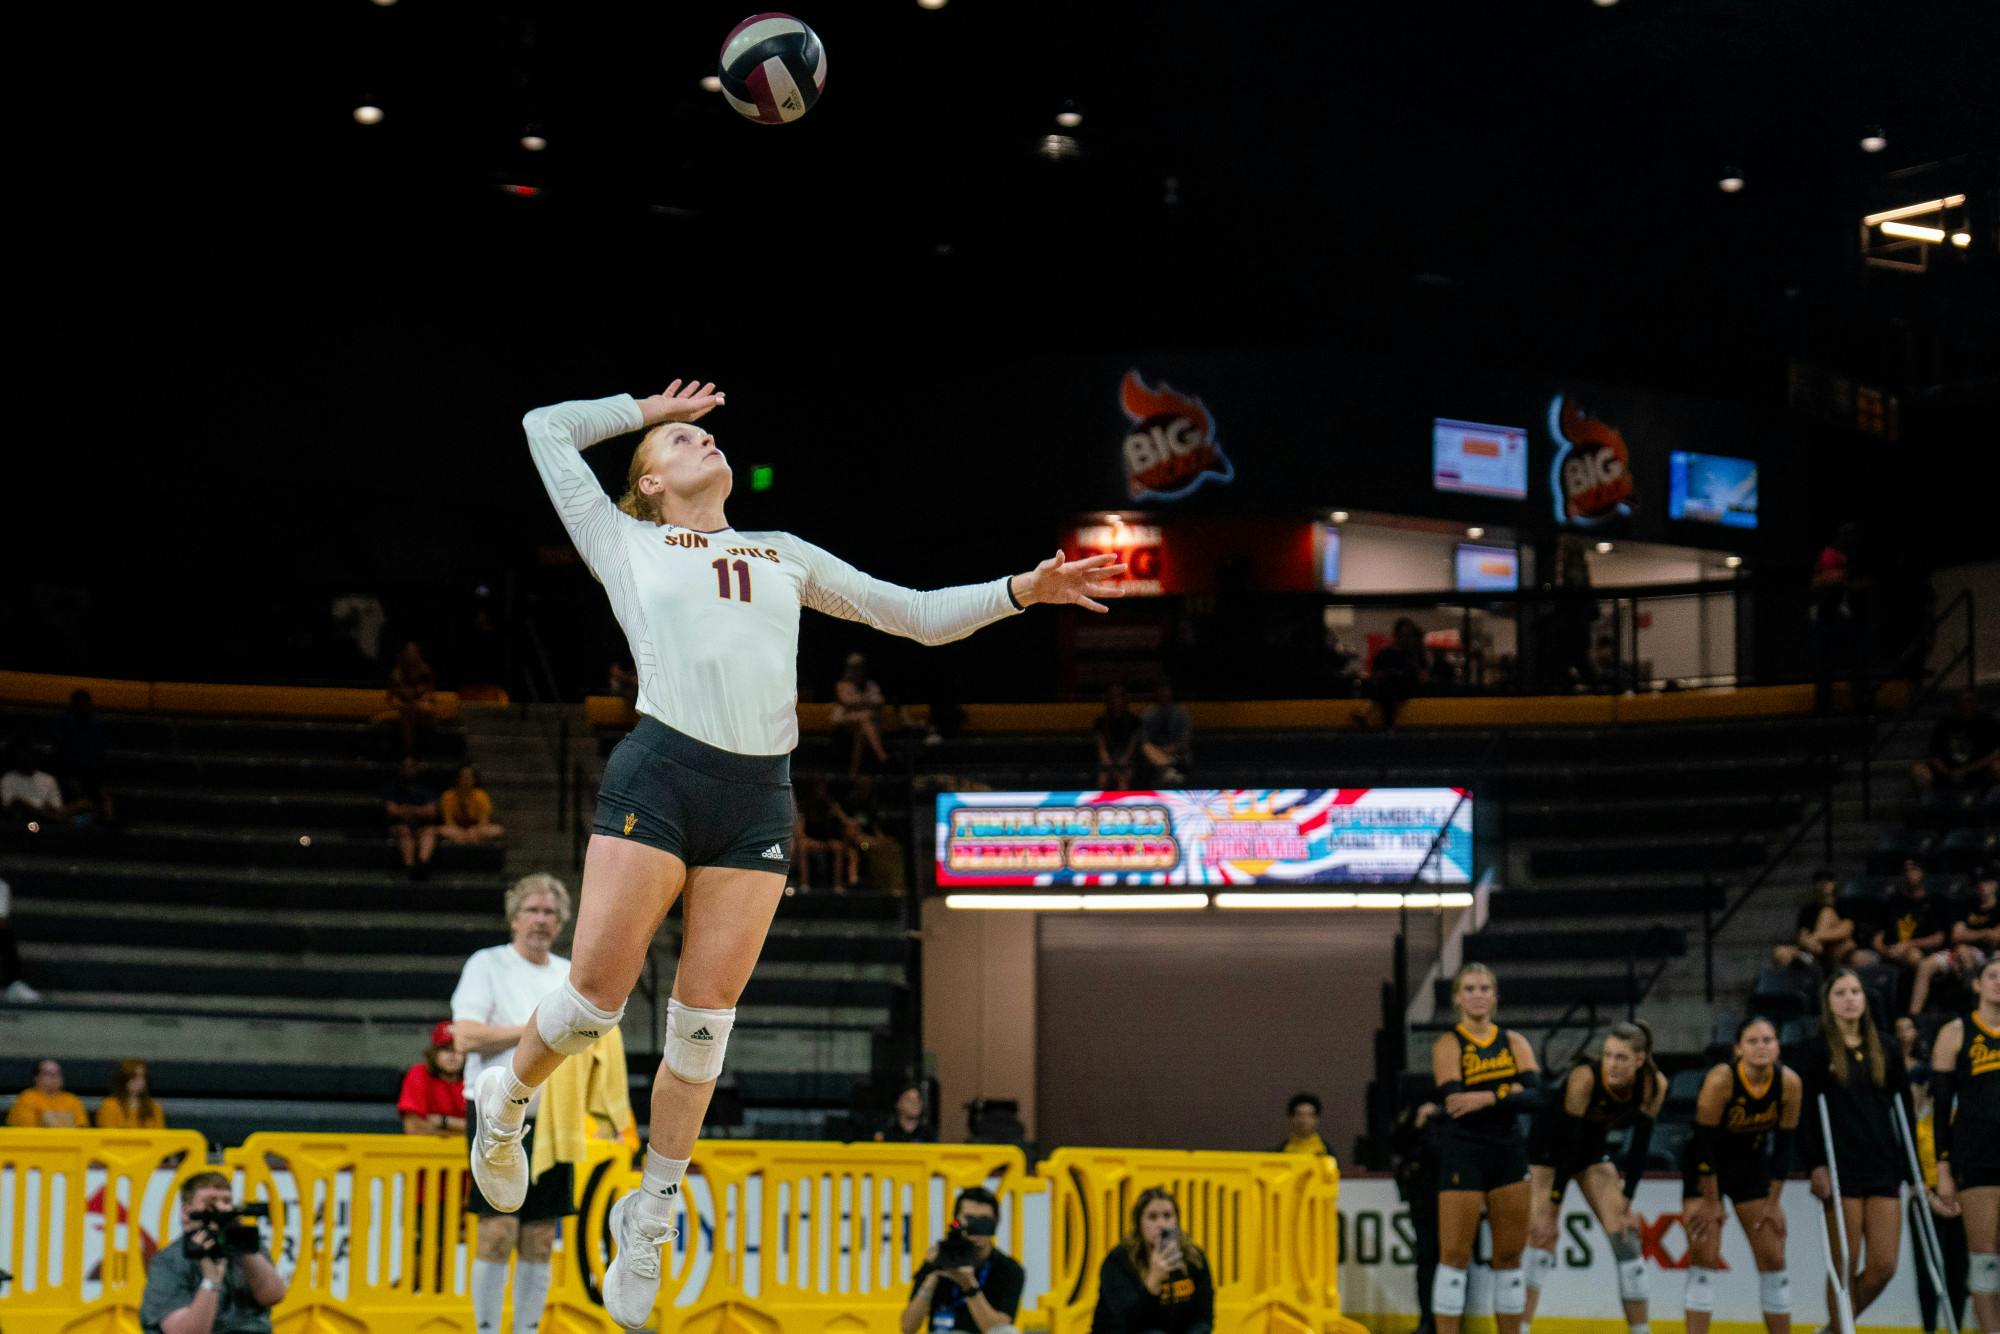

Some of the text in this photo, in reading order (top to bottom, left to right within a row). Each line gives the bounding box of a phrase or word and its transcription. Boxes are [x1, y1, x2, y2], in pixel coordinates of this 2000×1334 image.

[1124, 418, 1201, 474] BIG
[1564, 447, 1622, 496] BIG
[665, 533, 709, 548] SUN
[711, 557, 752, 603] 11
